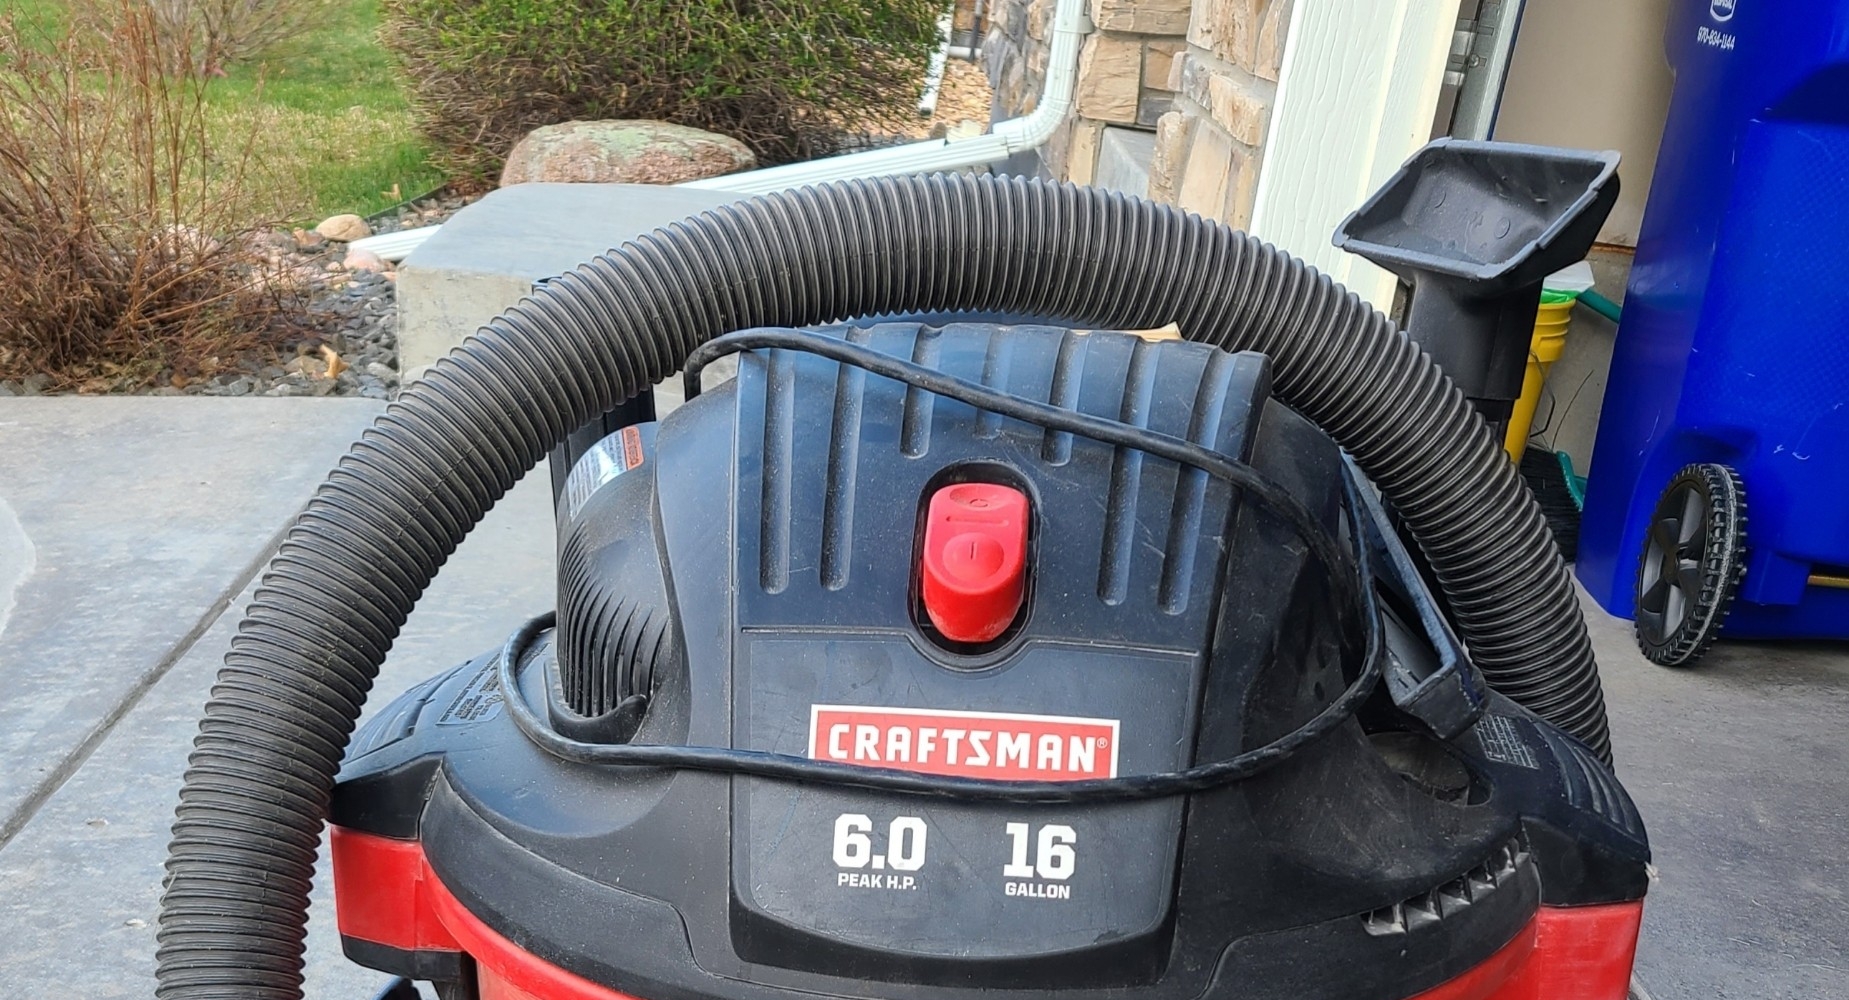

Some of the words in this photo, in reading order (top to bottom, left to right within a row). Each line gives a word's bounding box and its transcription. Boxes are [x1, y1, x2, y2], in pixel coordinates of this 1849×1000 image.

[832, 813, 928, 872] 6.0
[1003, 822, 1077, 880] 16
[837, 873, 883, 889] PEAK
[886, 874, 917, 891] H.P.
[1005, 881, 1070, 899] GALLON
